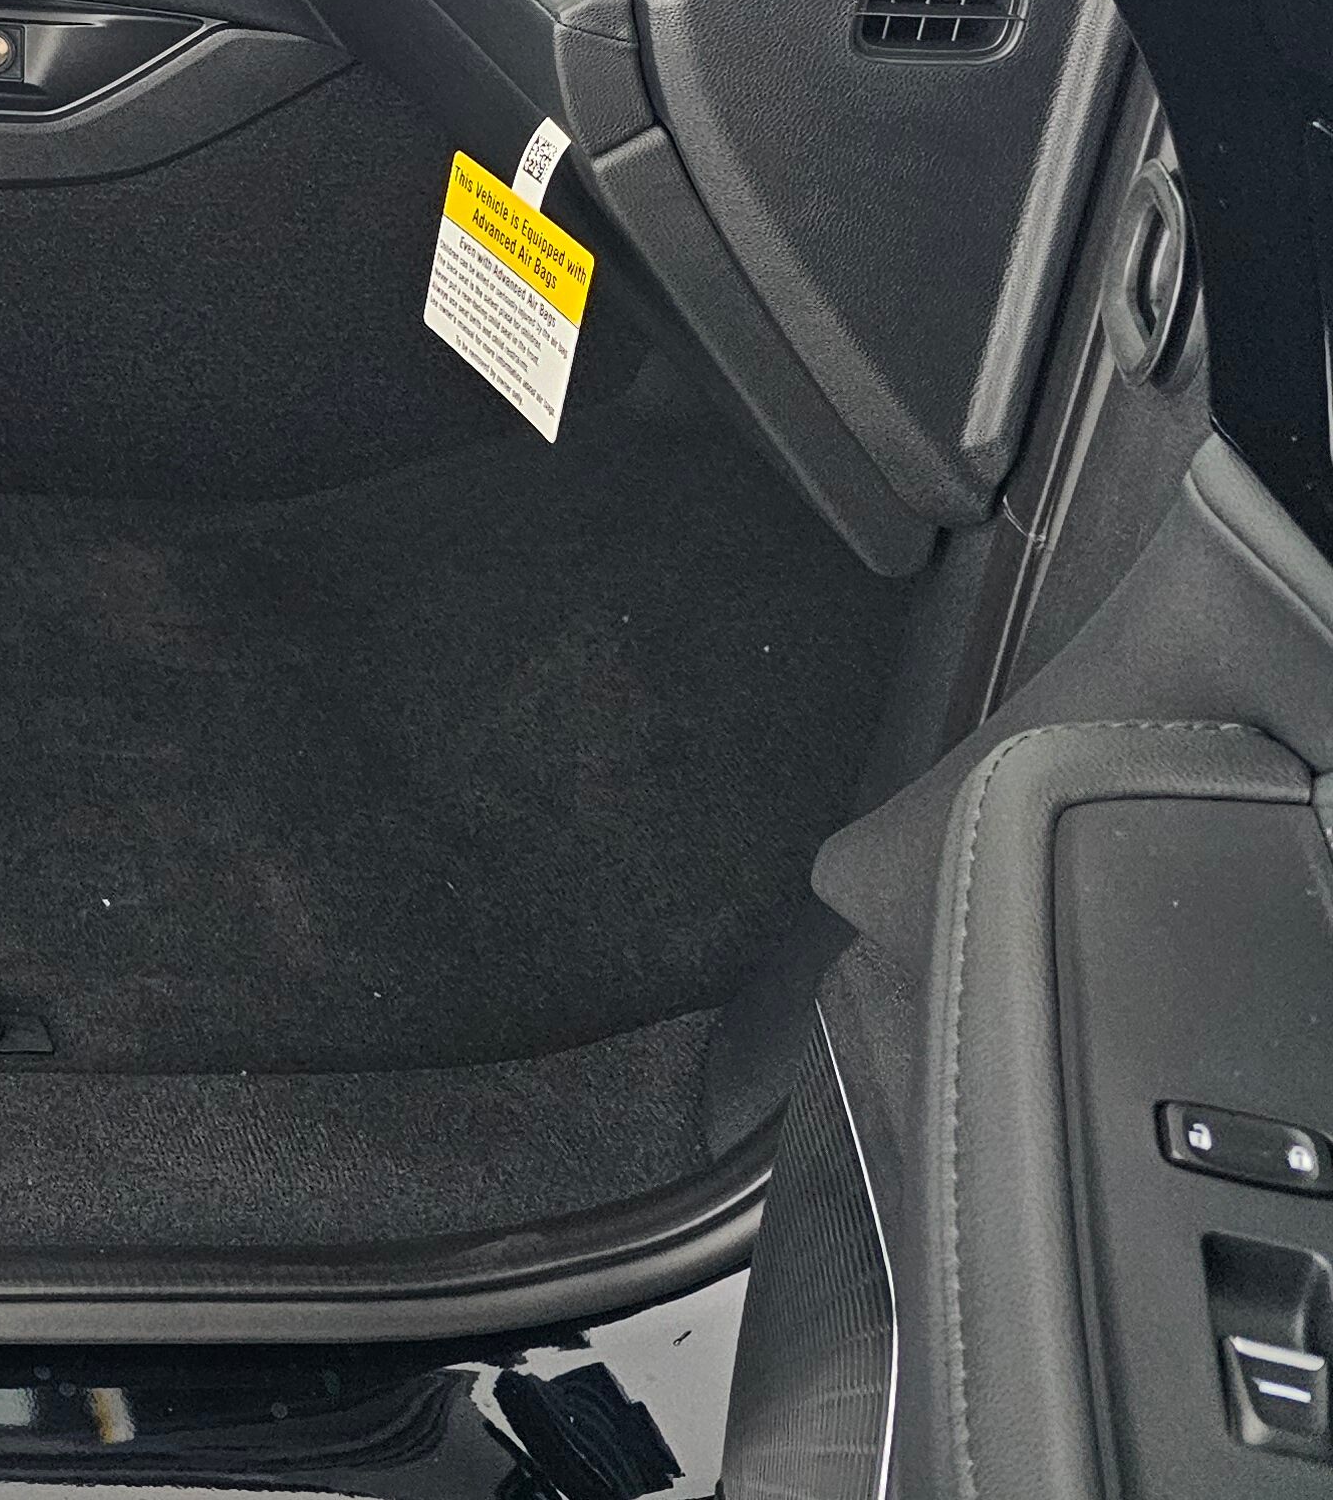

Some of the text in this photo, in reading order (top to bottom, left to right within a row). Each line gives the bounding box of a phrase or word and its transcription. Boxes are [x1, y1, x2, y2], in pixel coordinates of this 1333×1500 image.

[454, 164, 586, 285] This Vehicle is Equipped with
[471, 207, 557, 289] Advanced Air Bags
[459, 235, 556, 327] Even with Advanced Air Bags
